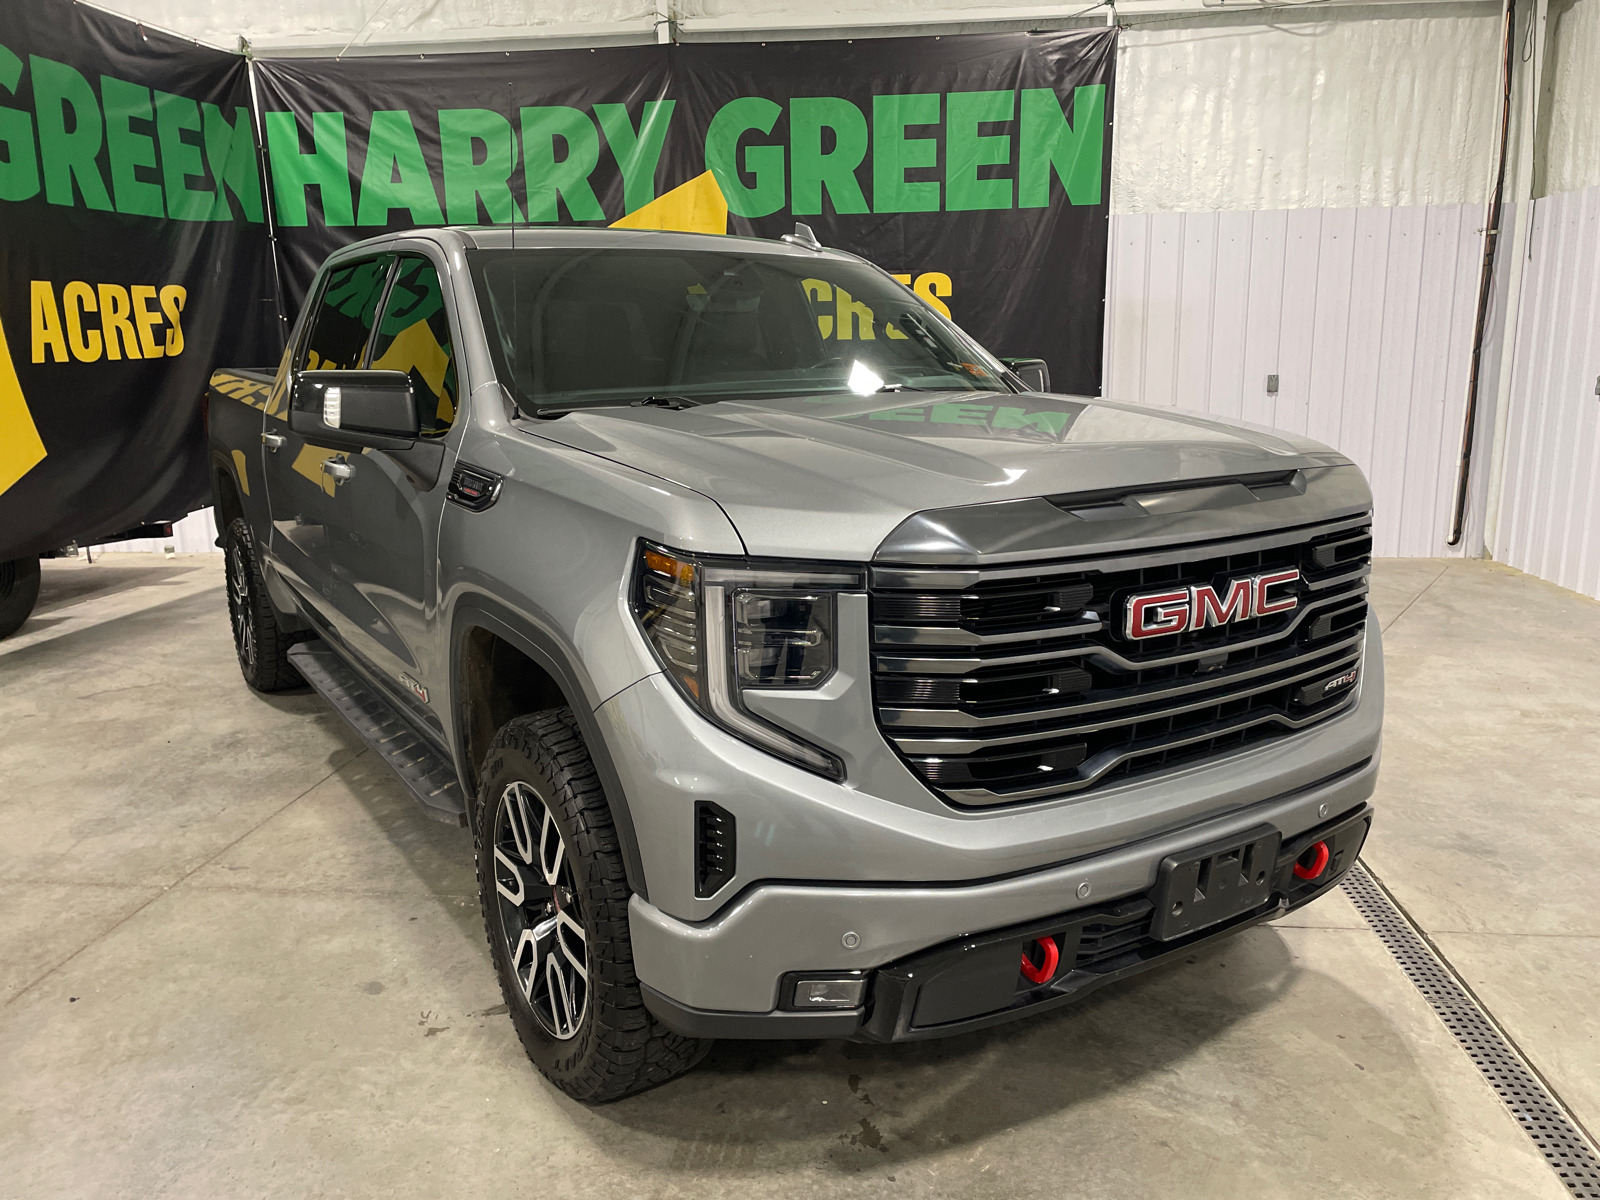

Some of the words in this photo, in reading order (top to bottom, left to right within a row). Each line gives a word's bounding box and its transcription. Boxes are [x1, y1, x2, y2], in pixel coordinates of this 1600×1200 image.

[265, 99, 676, 227] HARRY
[705, 84, 1106, 218] GREEN
[30, 280, 187, 364] ACRES
[1126, 568, 1300, 641] GMC
[1324, 670, 1356, 691] AT4
